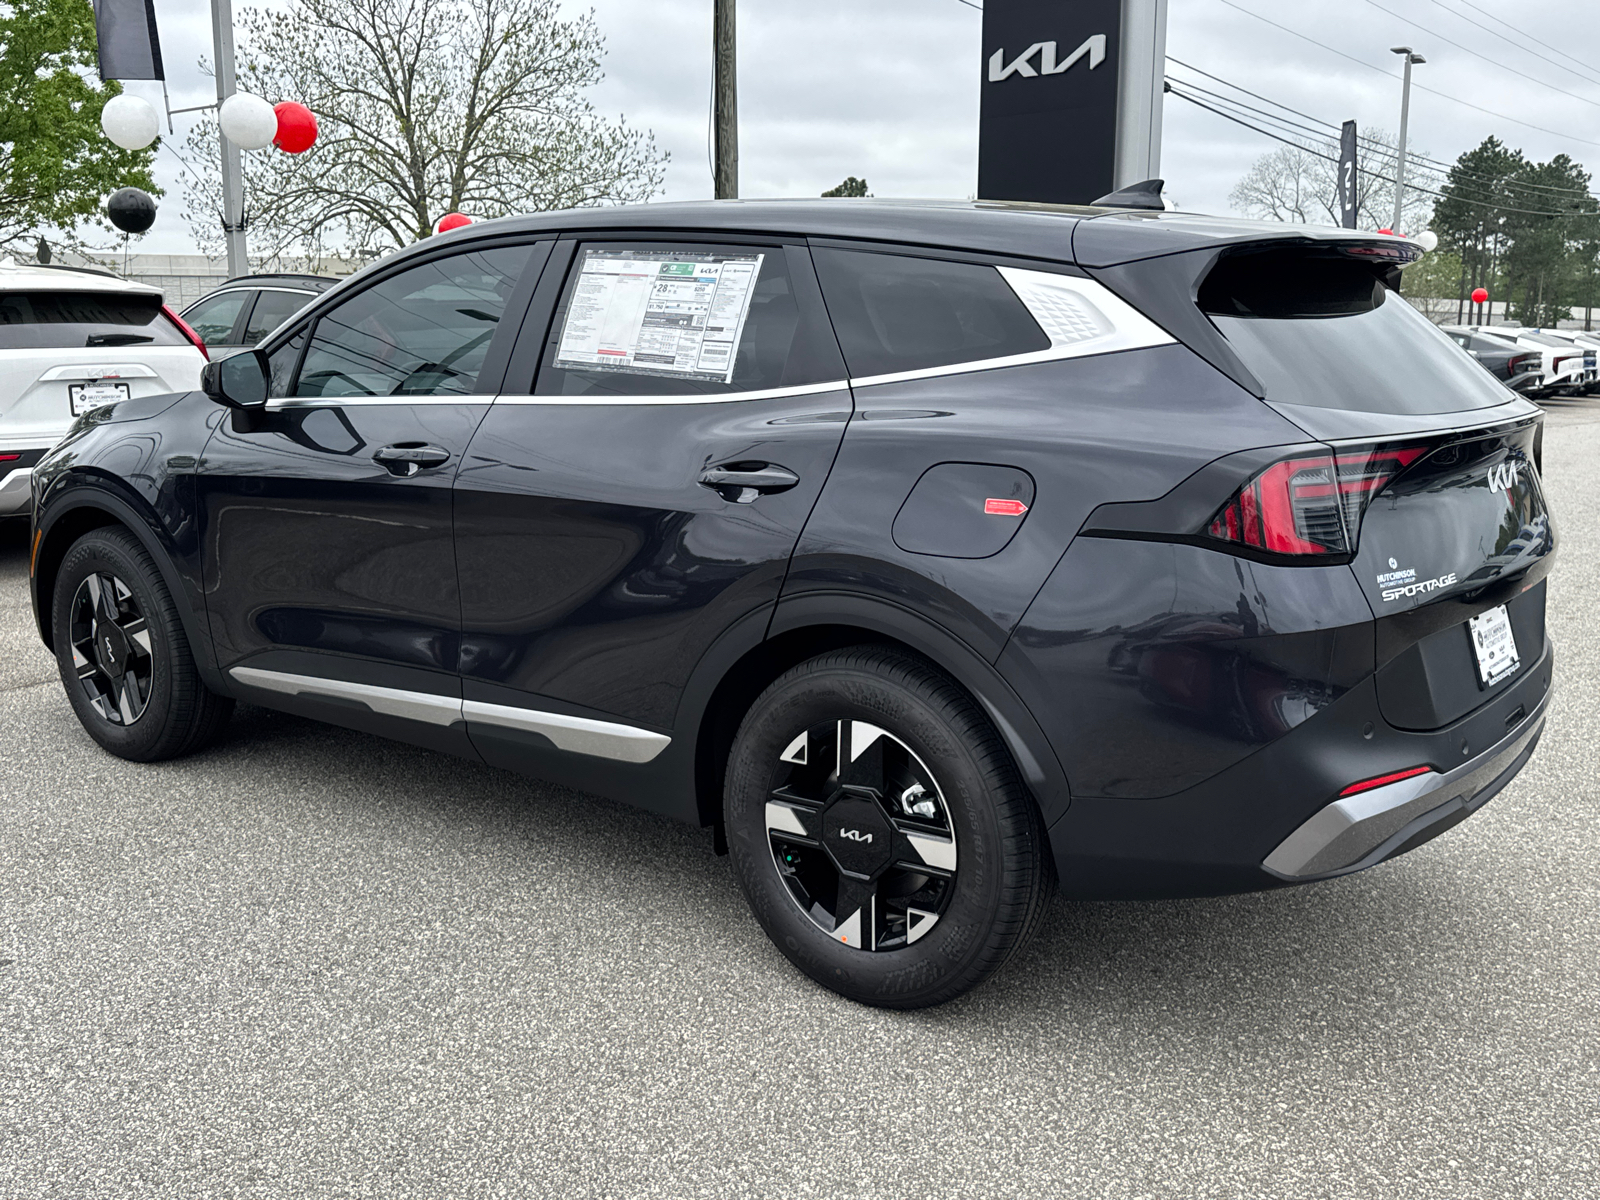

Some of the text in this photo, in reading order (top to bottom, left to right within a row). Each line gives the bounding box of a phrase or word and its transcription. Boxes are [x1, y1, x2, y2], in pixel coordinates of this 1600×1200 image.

[989, 34, 1107, 82] KIA
[657, 283, 669, 293] 28
[1487, 459, 1518, 493] KIA
[1376, 568, 1416, 584] HUTCHINSON
[1381, 572, 1458, 602] SPORTAGE
[955, 779, 980, 830] 235/65
[840, 827, 873, 844] KIA
